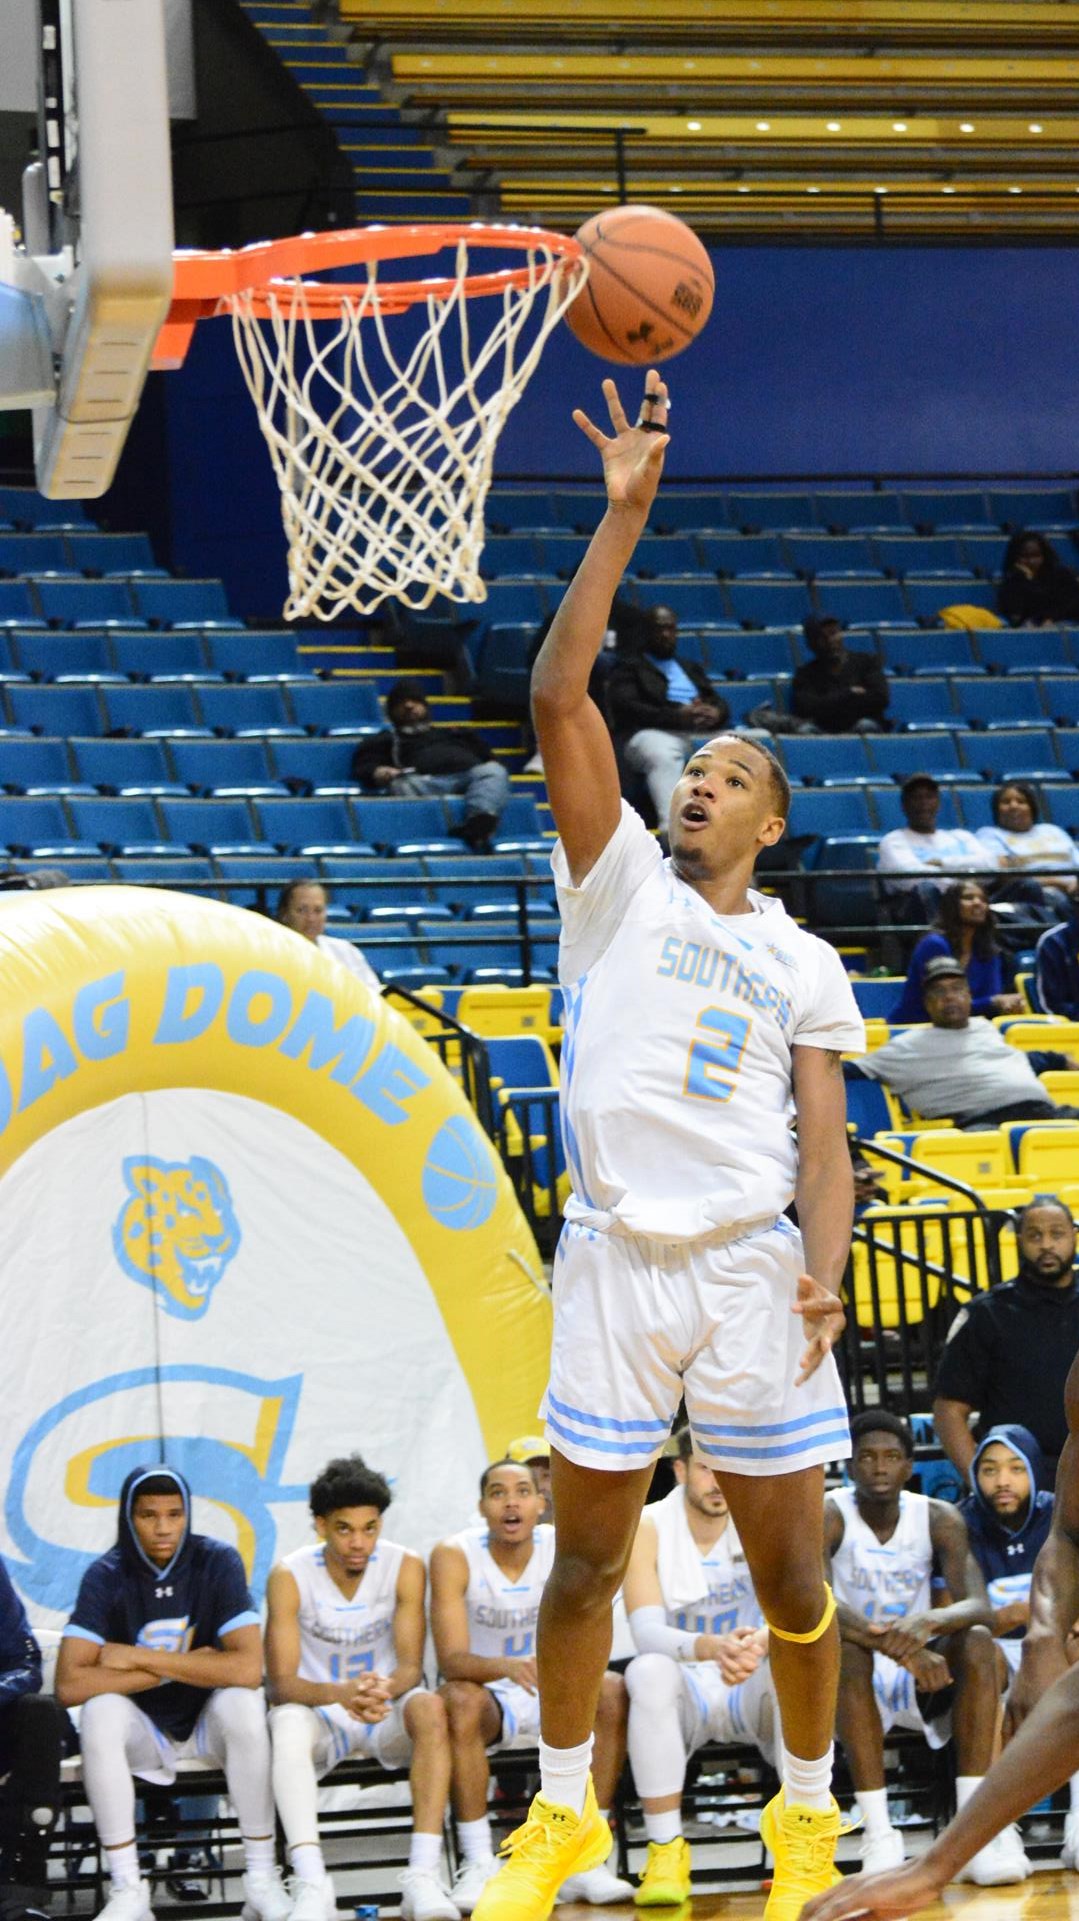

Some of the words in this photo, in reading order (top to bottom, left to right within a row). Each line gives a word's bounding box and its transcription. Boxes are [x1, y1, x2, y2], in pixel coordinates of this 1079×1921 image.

[656, 936, 794, 1030] SOUTHERN
[0, 969, 129, 1136] AG
[152, 962, 432, 1126] DOME
[682, 1005, 753, 1103] 2
[474, 1604, 540, 1630] SOUTHE
